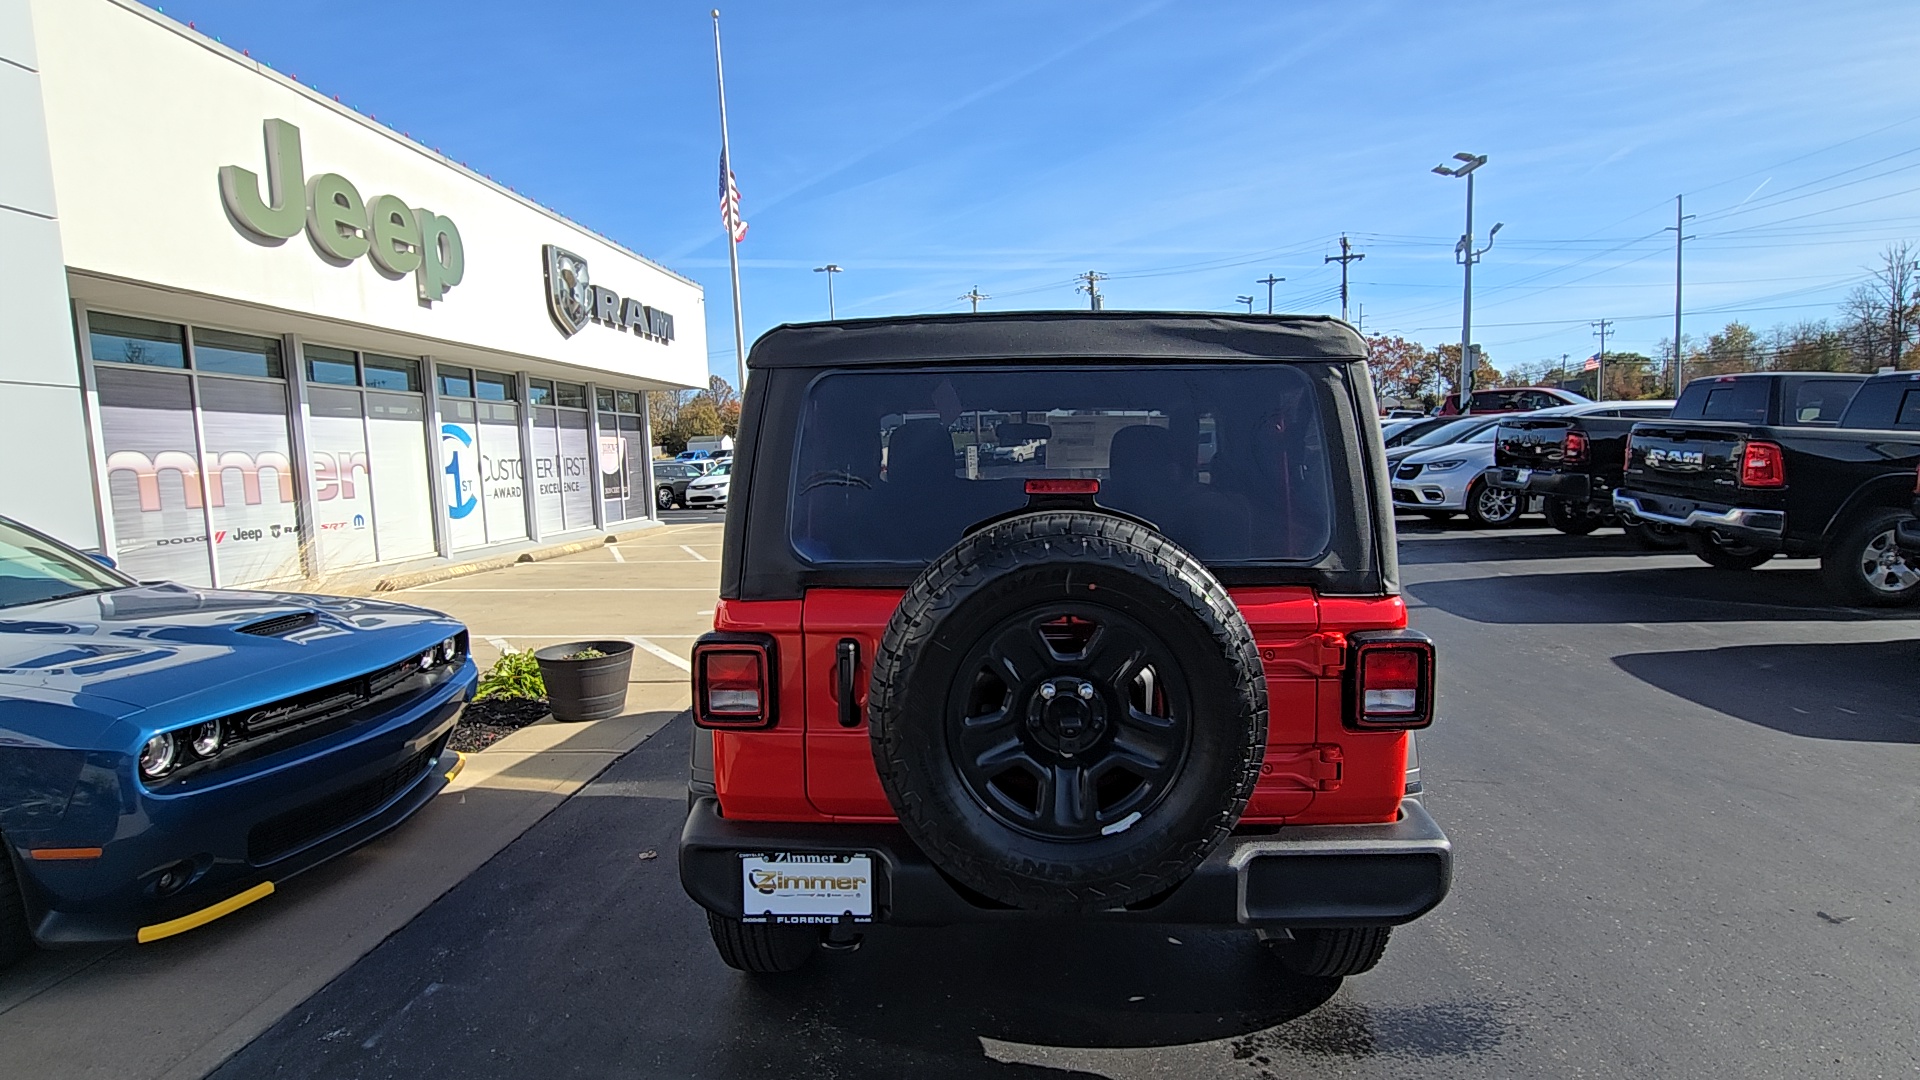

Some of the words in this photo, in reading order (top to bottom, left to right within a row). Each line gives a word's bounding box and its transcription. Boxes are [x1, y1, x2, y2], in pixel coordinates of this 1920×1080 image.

[219, 118, 464, 307] Jeep
[591, 286, 675, 344] RAM
[1648, 448, 1703, 465] RAM
[482, 455, 553, 482] CUSTOER
[493, 487, 522, 499] AWARD
[539, 481, 580, 495] EXCELENCE
[233, 528, 263, 541] Jeep
[320, 522, 347, 530] SRT
[157, 535, 208, 546] DODG
[775, 853, 837, 863] Zimmer
[756, 870, 866, 890] Zimmer
